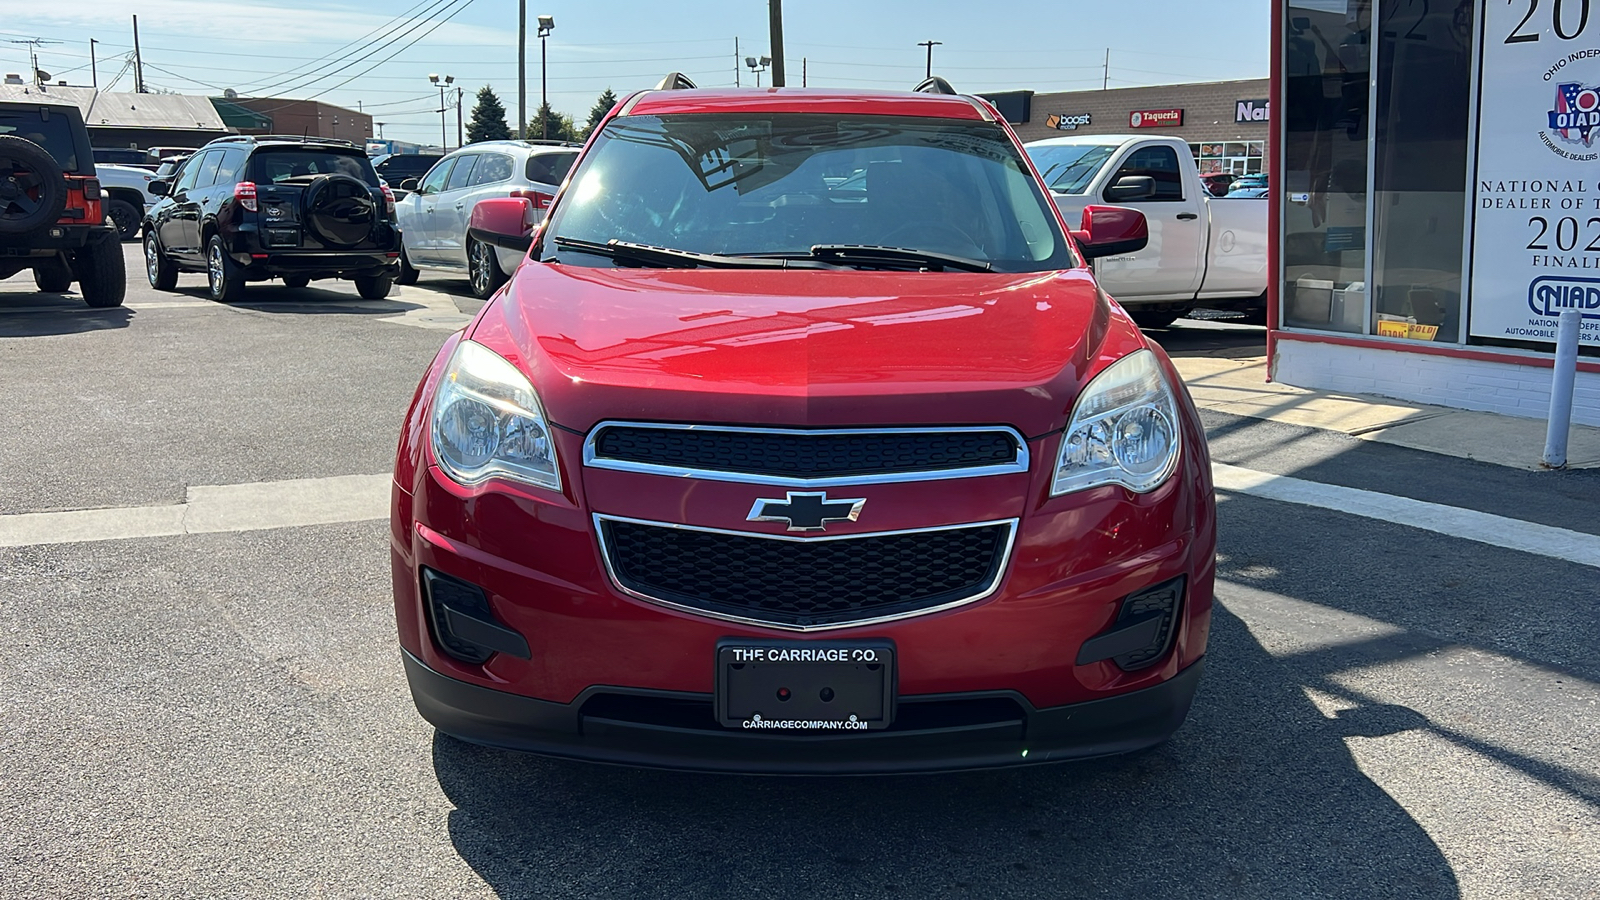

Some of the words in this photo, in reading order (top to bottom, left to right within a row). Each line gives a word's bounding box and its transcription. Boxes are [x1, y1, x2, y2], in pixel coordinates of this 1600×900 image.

[1543, 59, 1567, 81] OHIO
[1237, 102, 1270, 121] Nai
[1060, 113, 1090, 125] boost
[1557, 112, 1600, 128] OIAD
[1538, 130, 1569, 159] AUTOMOBILE
[1569, 152, 1598, 161] DEALERS
[1480, 180, 1587, 192] NATIONAL
[1482, 198, 1551, 209] DEALER
[1561, 198, 1584, 210] OF
[1409, 324, 1434, 334] SOLD
[1528, 319, 1559, 328] NATION
[1505, 327, 1555, 338] AUTOMOBILE
[733, 649, 764, 661] THE
[768, 649, 848, 661] CARRIAGE
[852, 649, 879, 661] CO.
[742, 720, 868, 729] CARRIAGECOMPANY.COM
